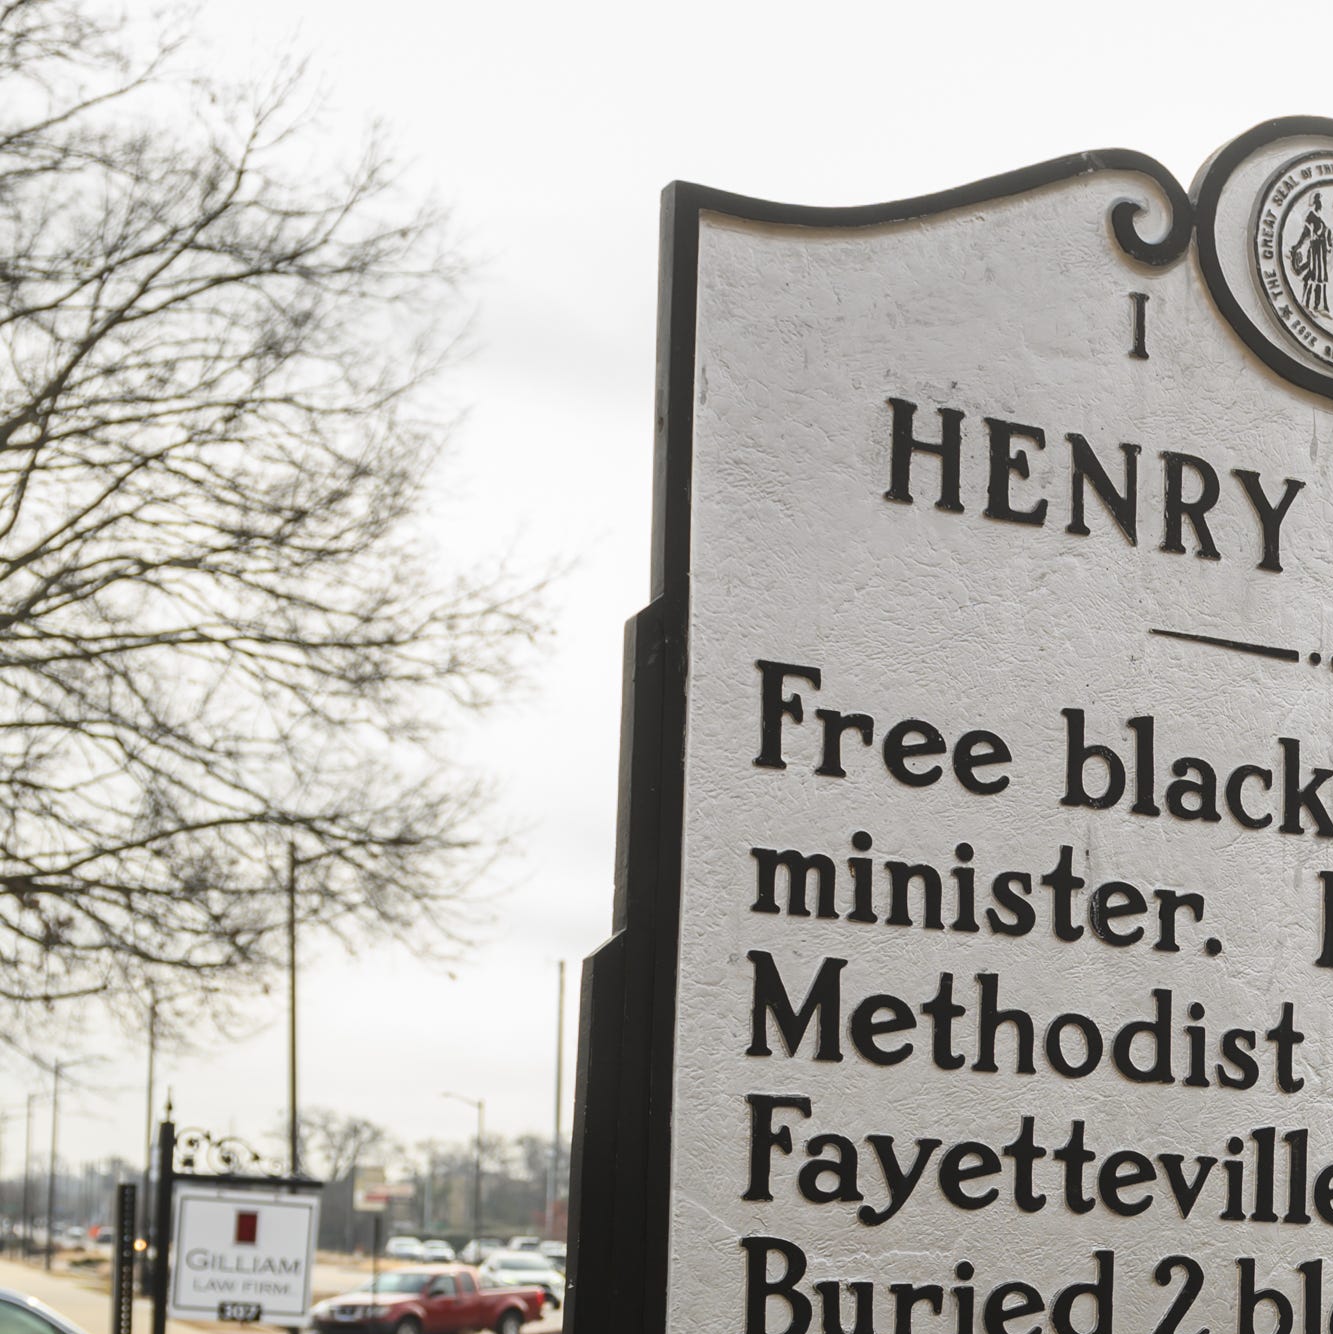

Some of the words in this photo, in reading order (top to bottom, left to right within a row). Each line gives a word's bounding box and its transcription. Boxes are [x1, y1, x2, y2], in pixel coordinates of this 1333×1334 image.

[1272, 175, 1298, 207] SEAL
[1300, 166, 1315, 180] OF
[1263, 209, 1278, 259] GREAT
[1265, 270, 1284, 301] THE
[883, 397, 1308, 574] HENRY
[752, 659, 1013, 796] Free
[749, 830, 1223, 958] minister.
[744, 949, 1305, 1095] Methodist
[185, 1247, 302, 1276] GILLIAM
[192, 1277, 235, 1294] LAW
[241, 1280, 290, 1296] FIRM
